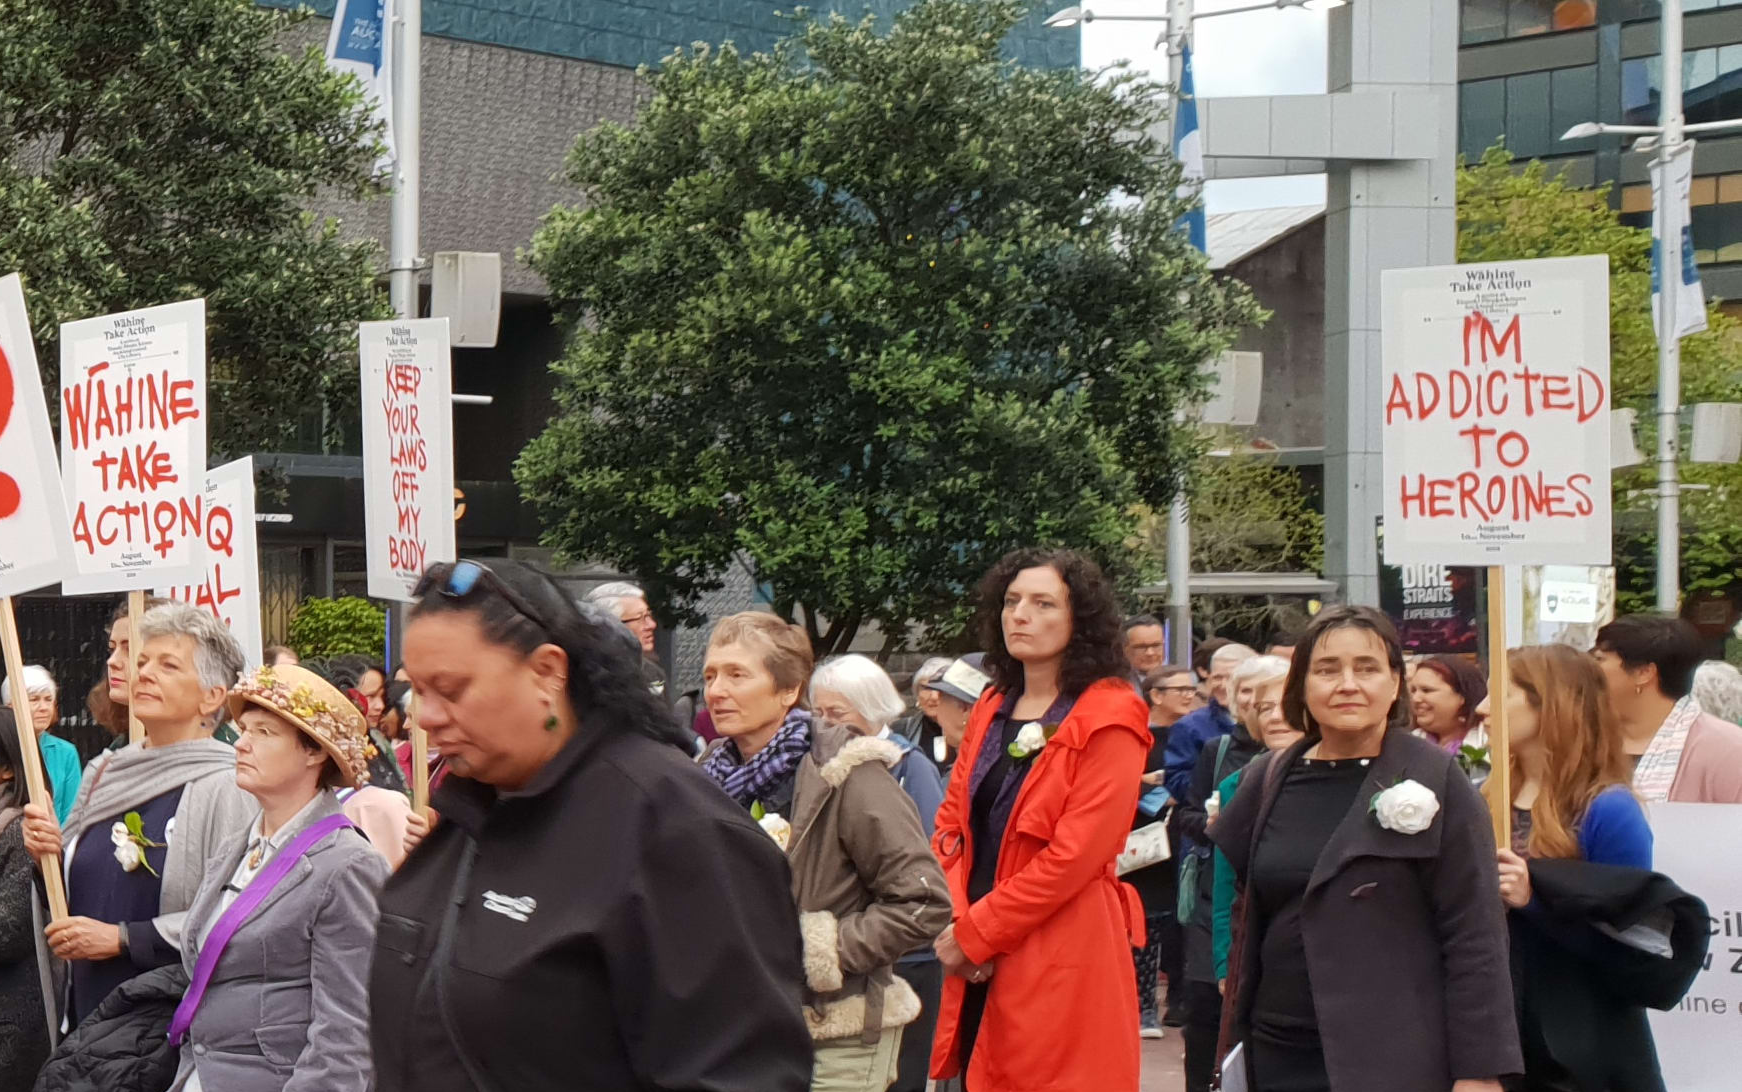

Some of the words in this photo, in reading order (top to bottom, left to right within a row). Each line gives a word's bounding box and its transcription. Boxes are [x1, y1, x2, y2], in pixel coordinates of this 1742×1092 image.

[1462, 310, 1522, 367] I'M
[385, 359, 422, 403] KEEP
[1385, 365, 1605, 426] ADDICTED
[382, 397, 421, 439] YOUR
[92, 440, 179, 493] TAKE
[390, 436, 427, 472] LAWS
[1458, 423, 1530, 469] TO
[392, 470, 419, 503] OFF
[1399, 470, 1594, 523] HEROINES
[72, 493, 202, 559] ACTION
[397, 503, 421, 540] MY
[389, 534, 427, 577] BODY
[1402, 563, 1454, 588] DIRE
[1403, 587, 1454, 604] STRAITS
